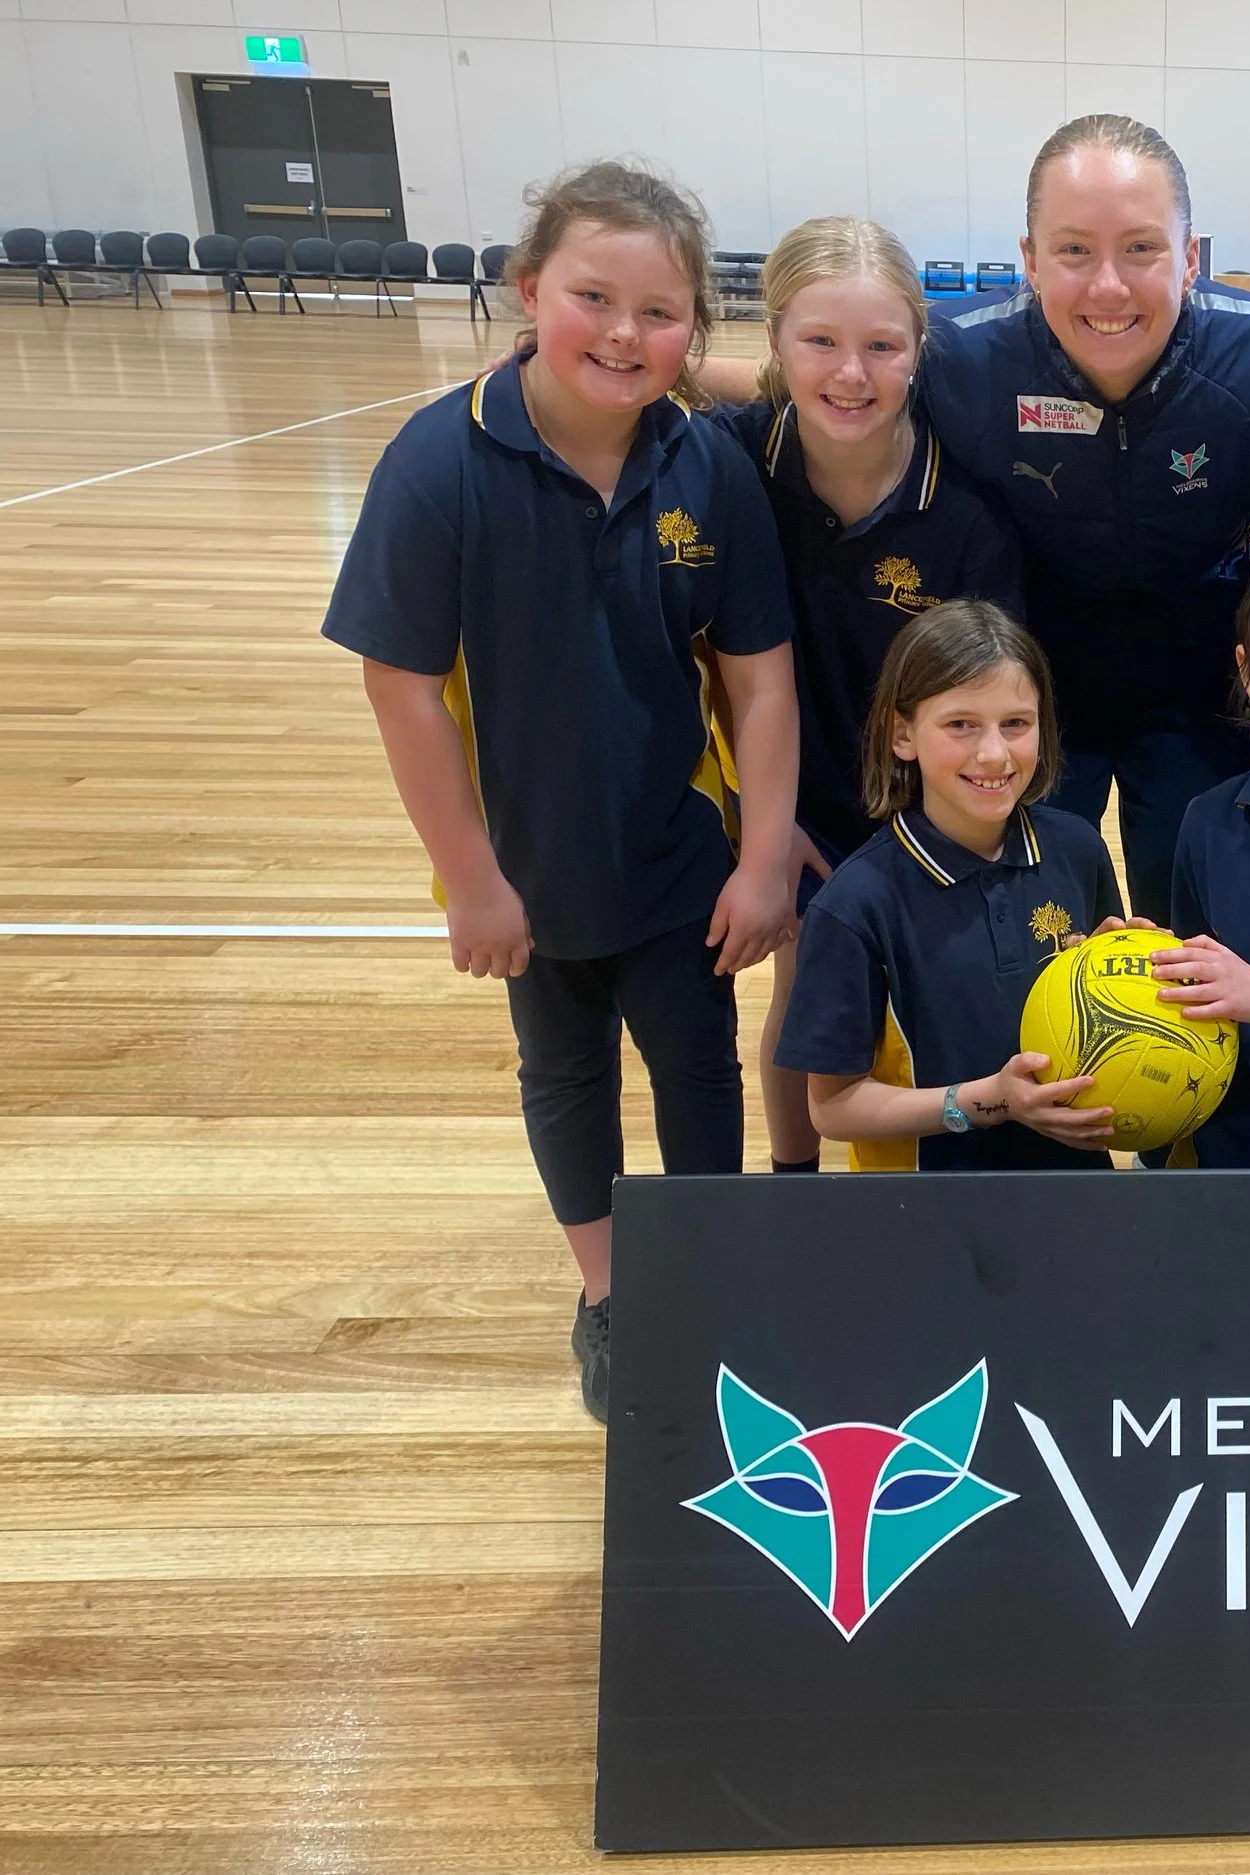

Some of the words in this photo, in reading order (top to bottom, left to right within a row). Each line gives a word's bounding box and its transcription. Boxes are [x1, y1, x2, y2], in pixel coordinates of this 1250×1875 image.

[1044, 403, 1084, 414] SUNCORP
[1044, 412, 1075, 421] SUPER
[1044, 420, 1086, 430] NETBALL
[1171, 481, 1209, 495] VIXENS
